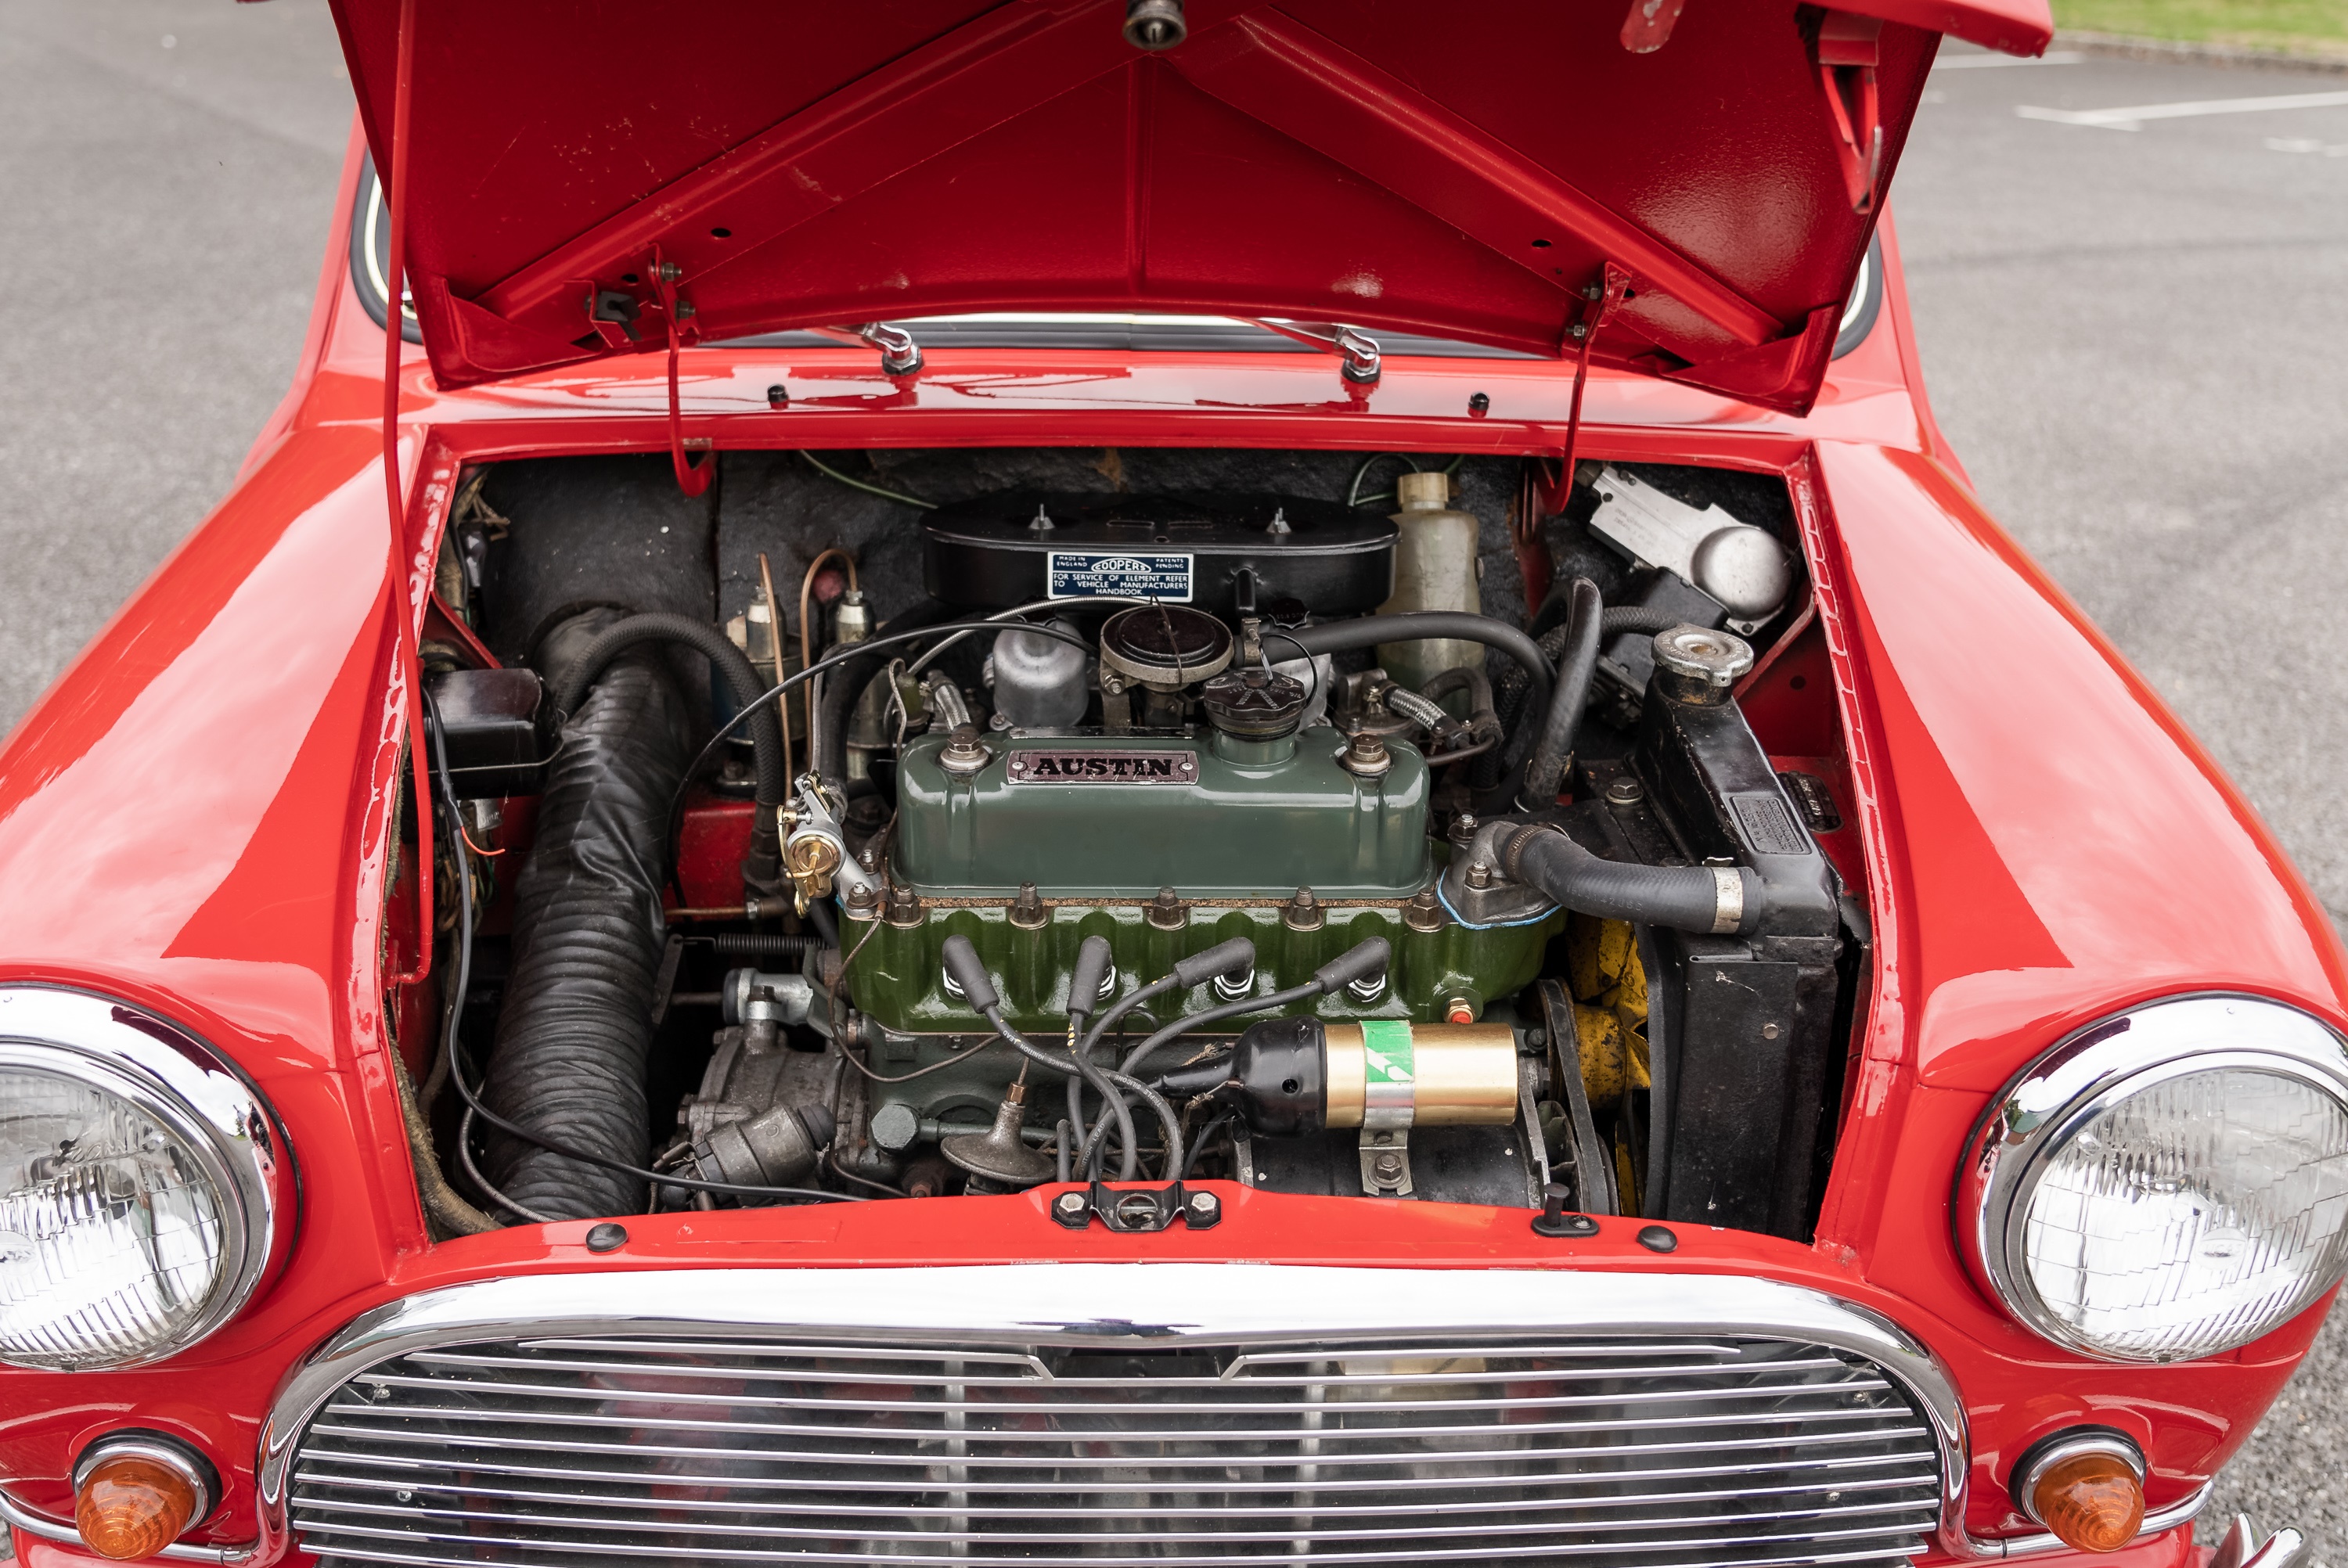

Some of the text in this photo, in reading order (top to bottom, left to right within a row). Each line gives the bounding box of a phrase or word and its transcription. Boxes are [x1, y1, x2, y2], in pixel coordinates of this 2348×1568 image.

[1094, 559, 1147, 571] COOPERS
[1120, 581, 1188, 590] MANUFACTURERS
[1033, 757, 1172, 776] AUSTIN
[1003, 1030, 1020, 1045] LEAD
[1020, 1043, 1045, 1061] IGNITION
[1115, 1074, 1142, 1090] SILICONE
[1143, 1088, 1162, 1107] TRIPLE
[1093, 1122, 1105, 1142] LEAD
